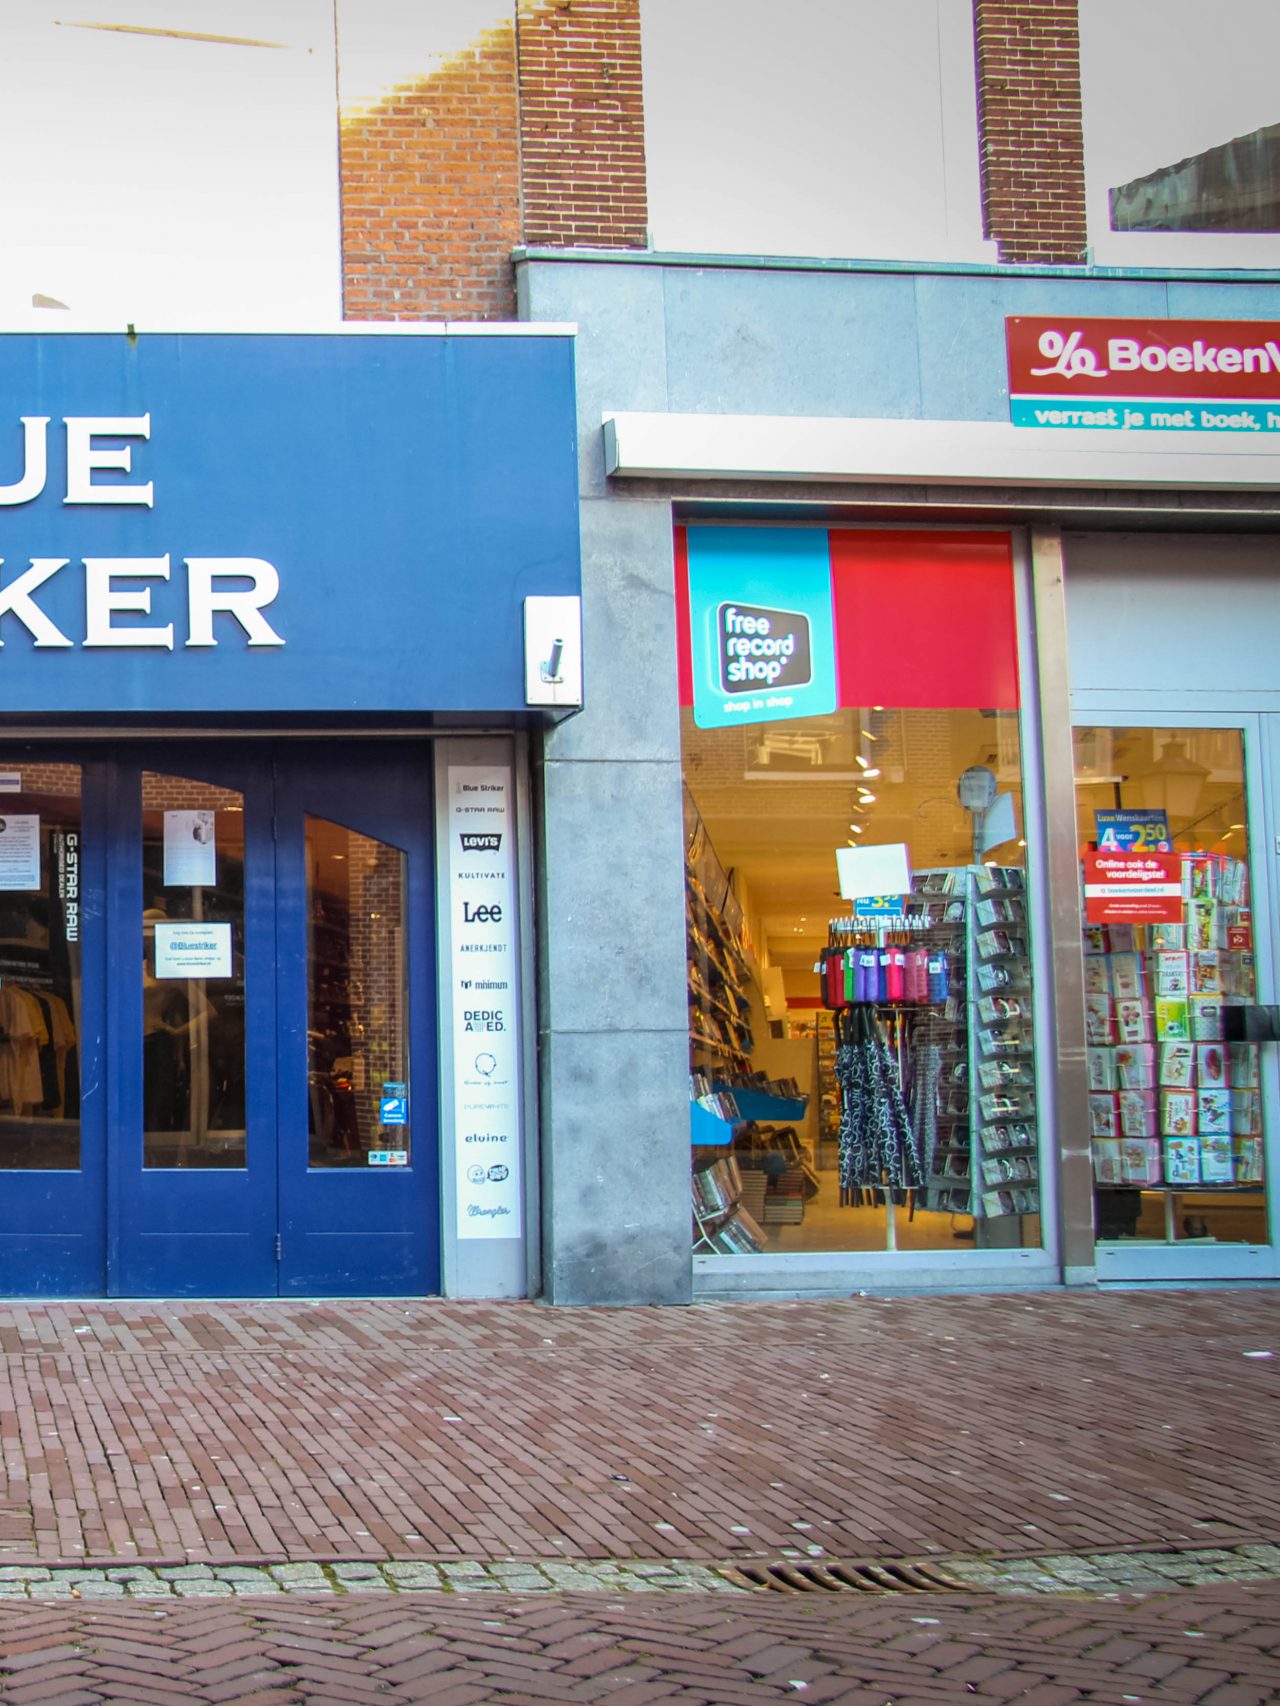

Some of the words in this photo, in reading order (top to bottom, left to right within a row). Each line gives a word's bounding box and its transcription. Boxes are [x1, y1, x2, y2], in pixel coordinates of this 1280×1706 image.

[1035, 409, 1118, 426] verrast
[1123, 409, 1145, 430] je
[1150, 411, 1195, 428] met
[1201, 411, 1261, 430] boek,
[725, 607, 770, 635] free
[726, 633, 794, 656] record
[727, 656, 782, 685] shop
[723, 701, 751, 713] shop
[753, 698, 764, 709] in
[766, 696, 794, 708] shop
[480, 784, 504, 792] Striker
[1095, 859, 1125, 869] Online
[1127, 860, 1144, 869] ook
[1146, 860, 1158, 868] de
[66, 902, 78, 942] RAW
[463, 901, 502, 924] Lee
[463, 1010, 503, 1021] DEDIC
[465, 1132, 508, 1143] elvine
